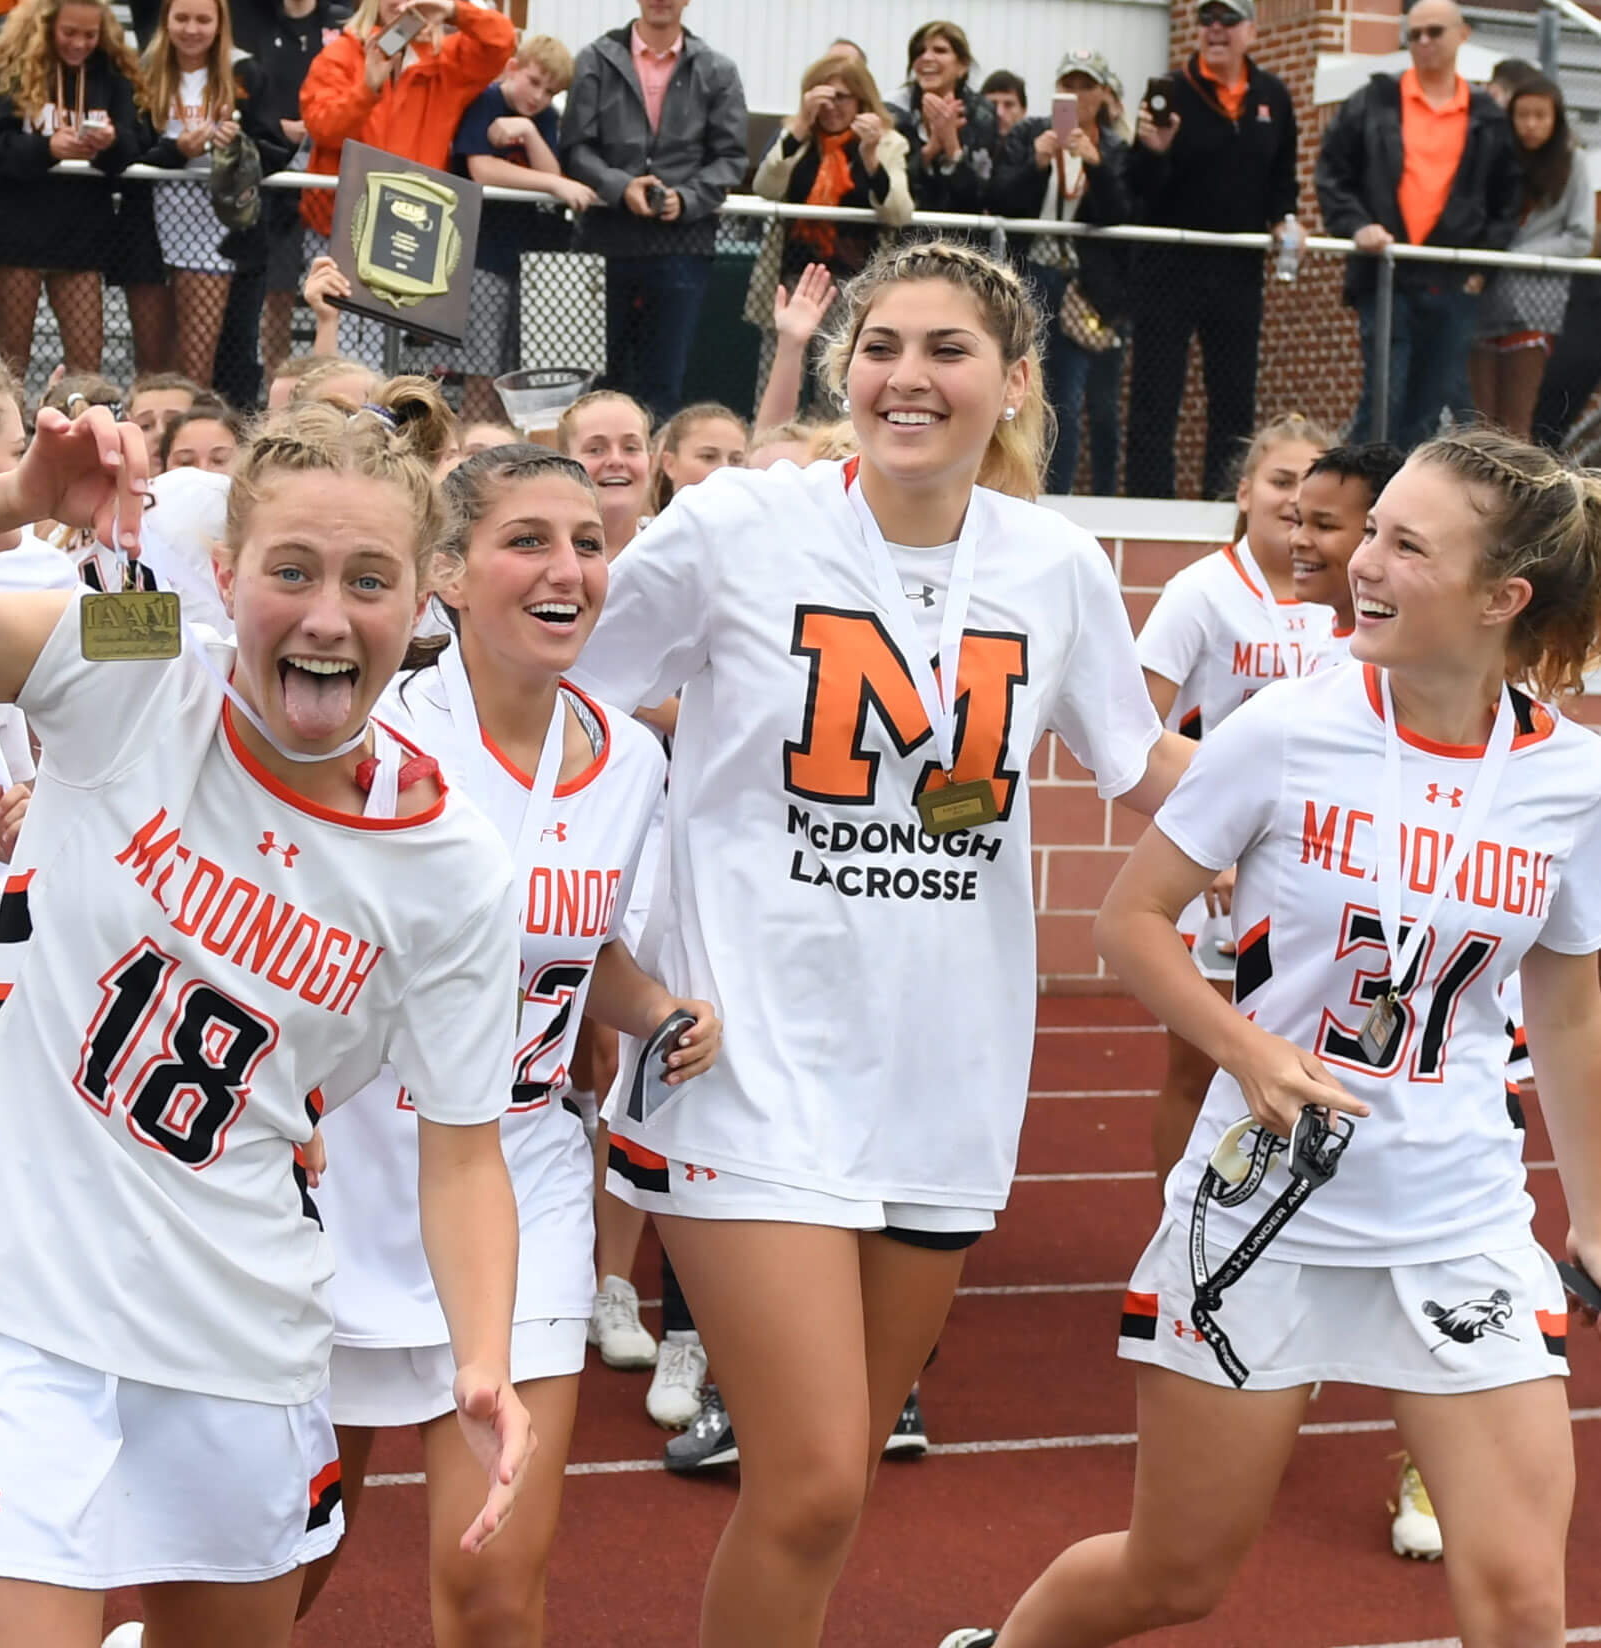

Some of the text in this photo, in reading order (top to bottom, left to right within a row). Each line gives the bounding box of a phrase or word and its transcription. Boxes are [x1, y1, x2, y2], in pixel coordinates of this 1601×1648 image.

[783, 604, 1028, 822] M
[790, 850, 978, 900] LACROSSE
[72, 935, 280, 1172] 18
[1314, 902, 1502, 1083] 31
[1247, 1206, 1288, 1253] UNDER
